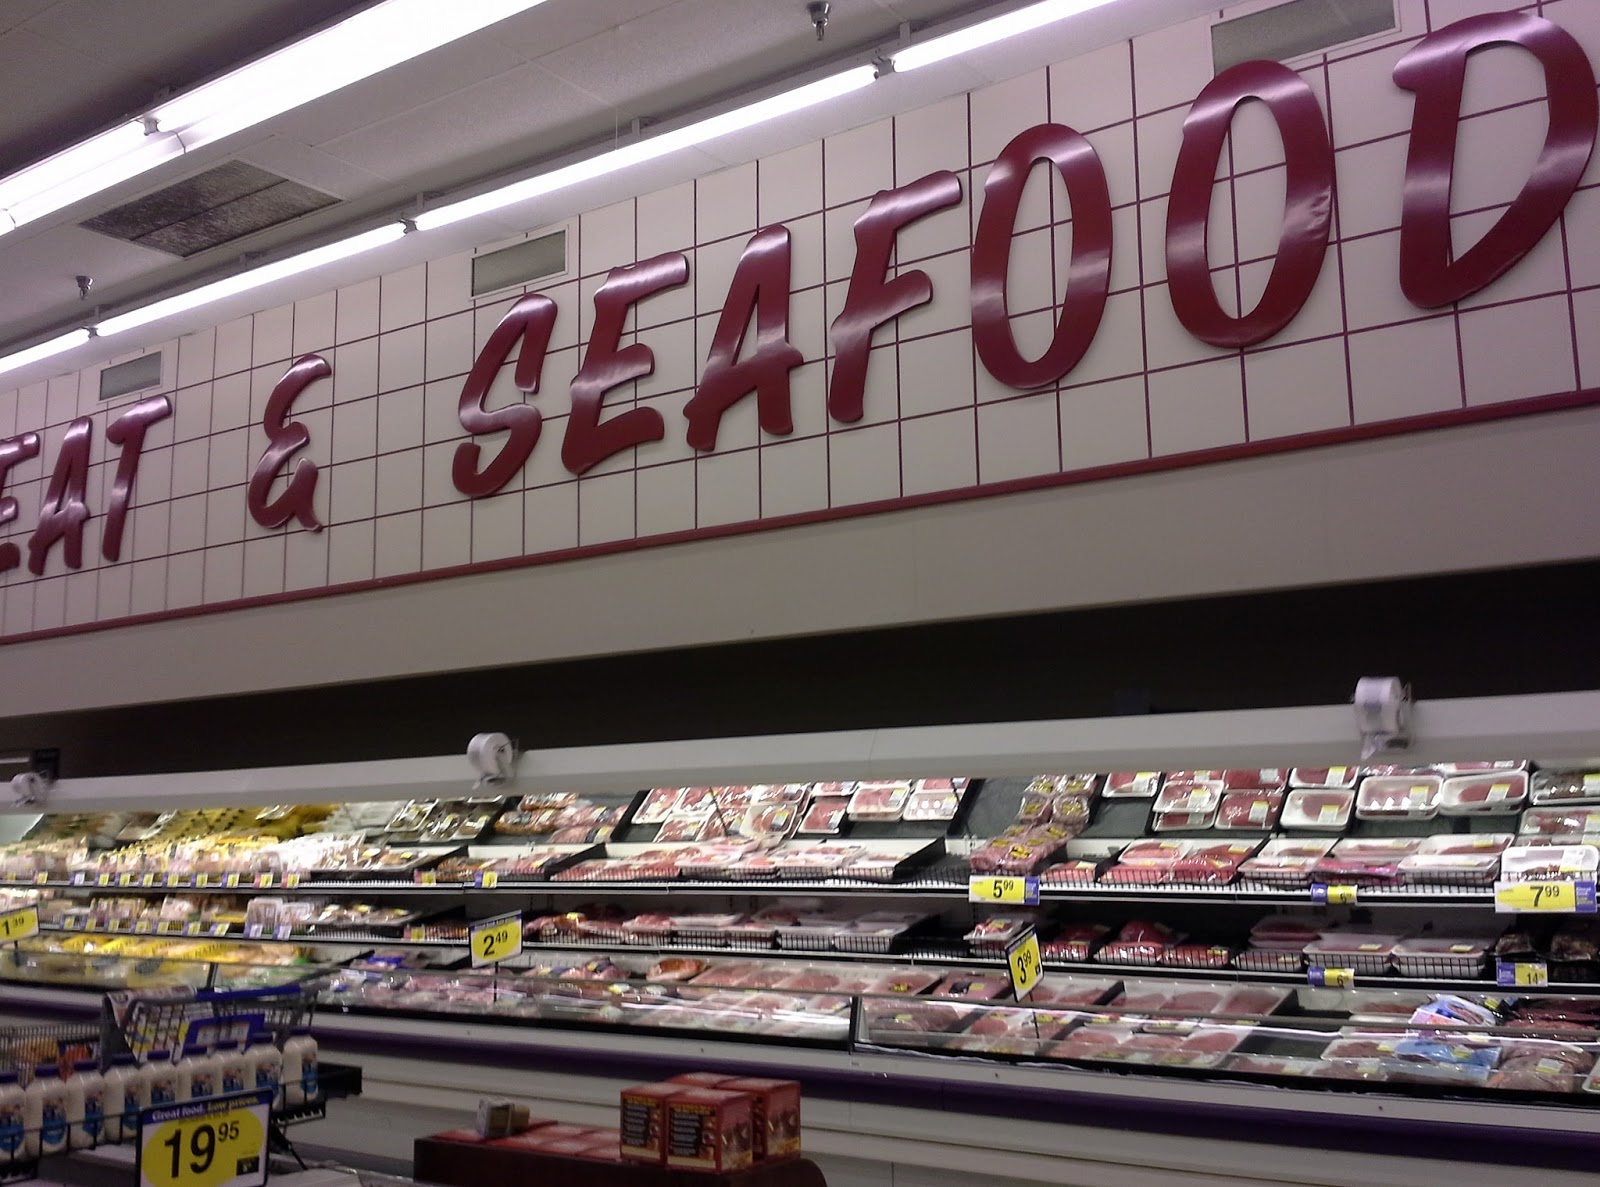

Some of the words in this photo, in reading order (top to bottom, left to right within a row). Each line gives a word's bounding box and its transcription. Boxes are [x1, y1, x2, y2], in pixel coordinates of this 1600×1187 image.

[248, 353, 332, 532] &
[449, 9, 1598, 499] SEAFOOD
[151, 1108, 181, 1121] Great
